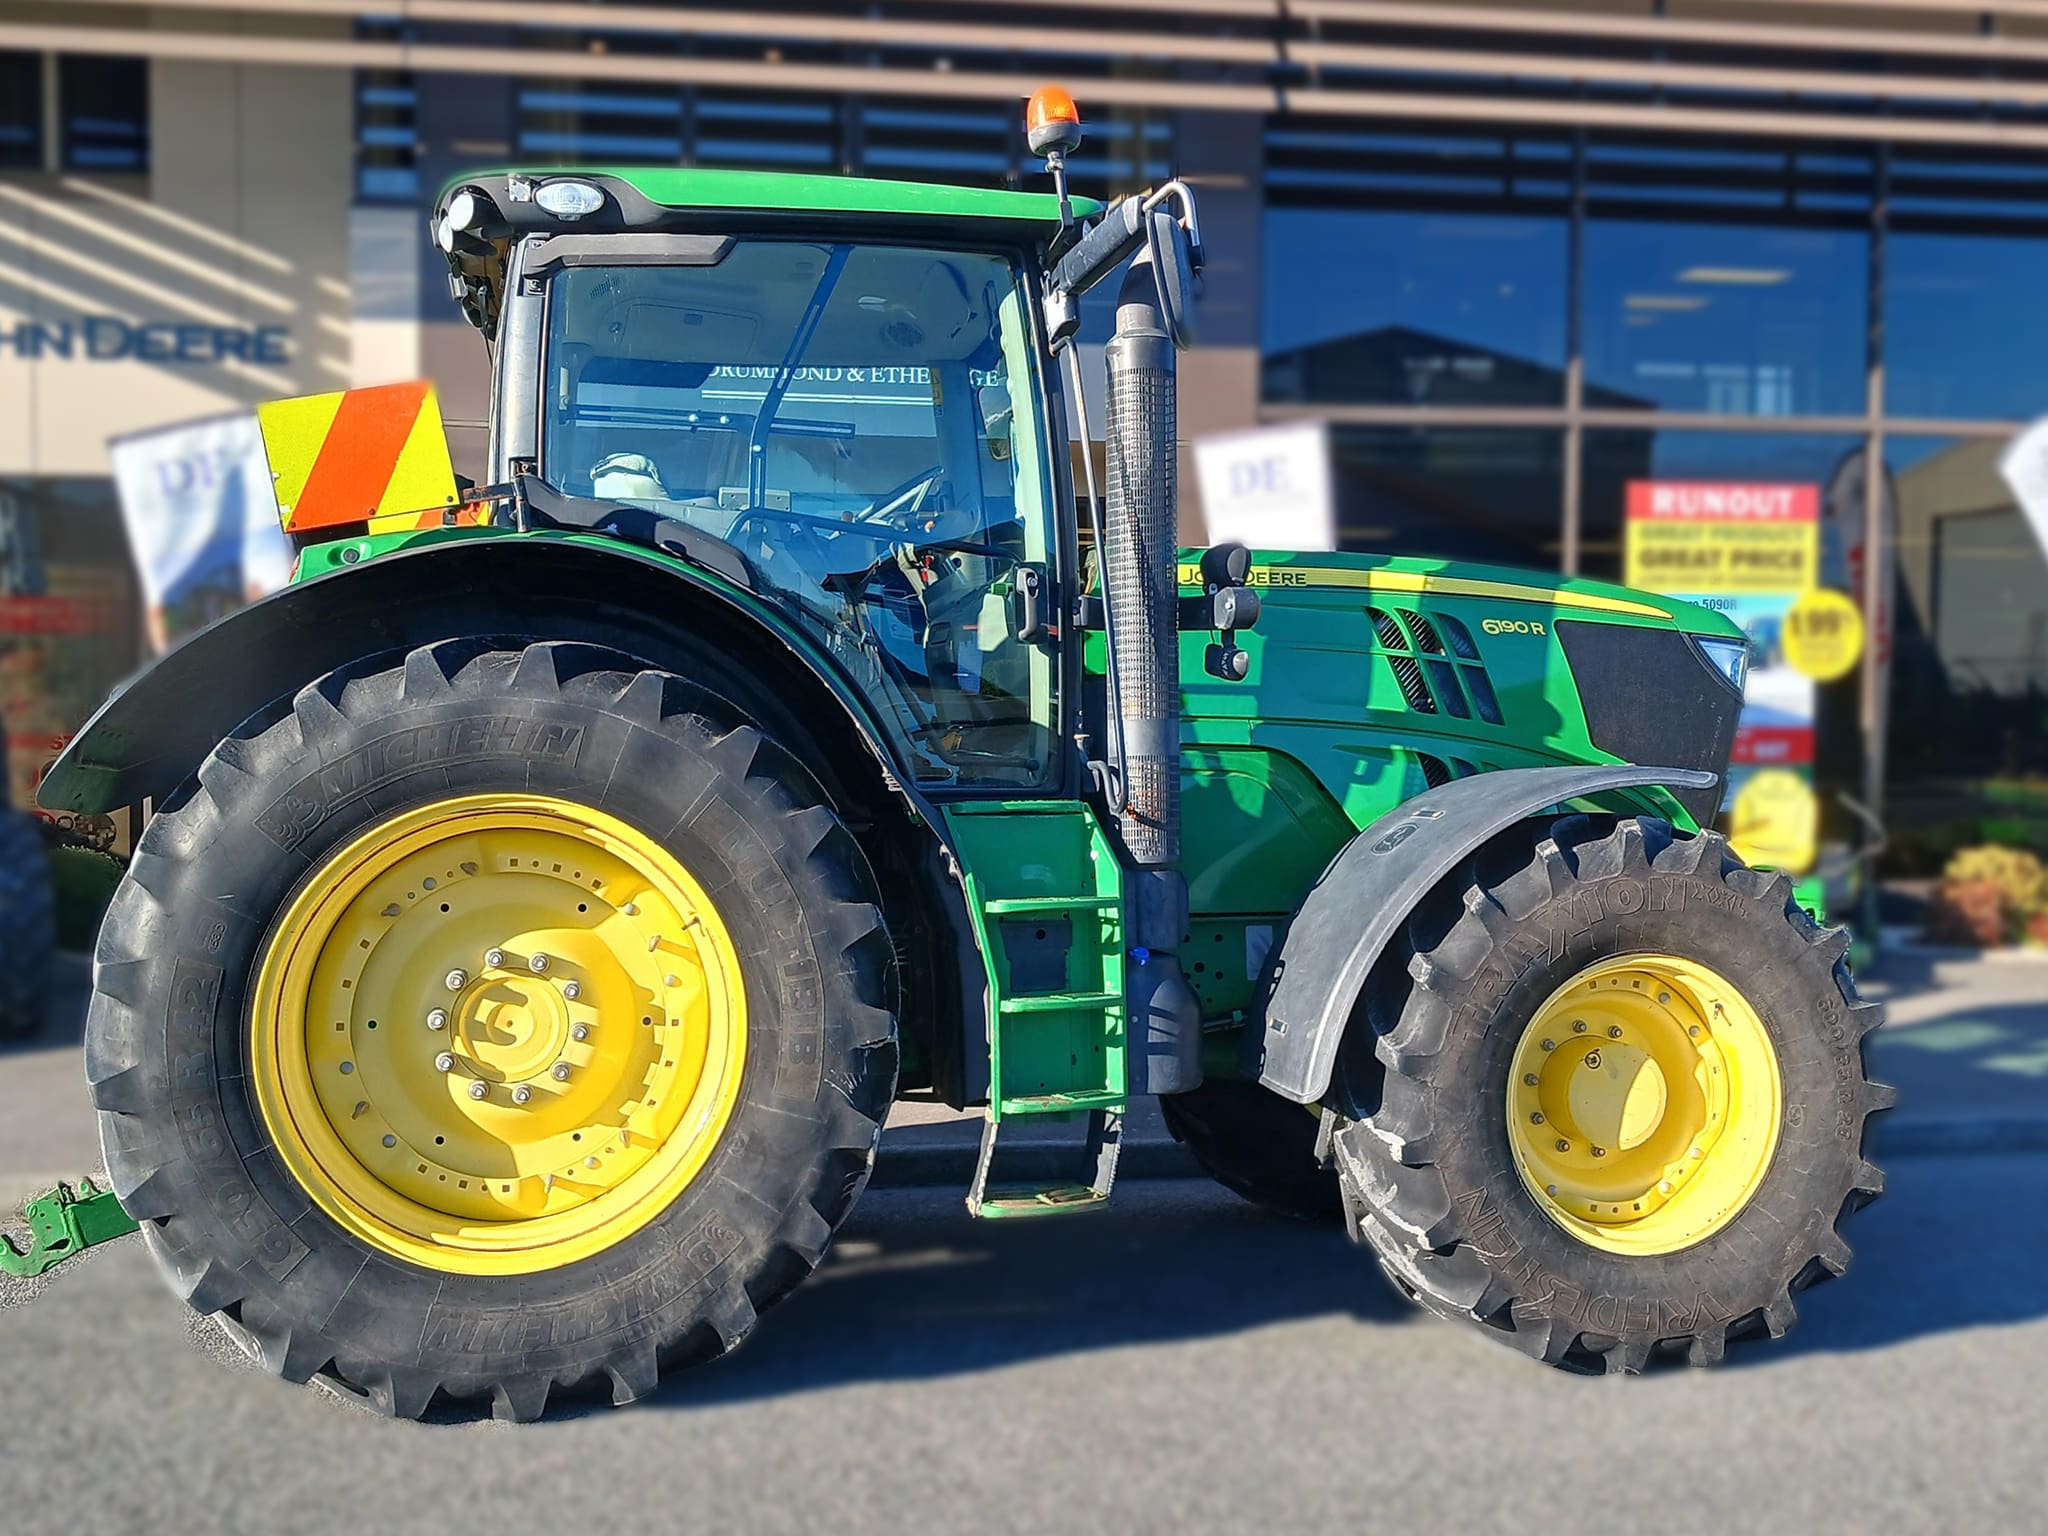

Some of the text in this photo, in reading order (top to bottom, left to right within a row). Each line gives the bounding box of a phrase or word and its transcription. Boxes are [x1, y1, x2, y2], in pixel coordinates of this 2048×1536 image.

[86, 315, 292, 364] DEERE
[847, 367, 865, 382] &
[1652, 488, 1793, 516] RUNOUT
[320, 718, 582, 803] MICHELIN
[1452, 877, 1688, 1040] TRAXION
